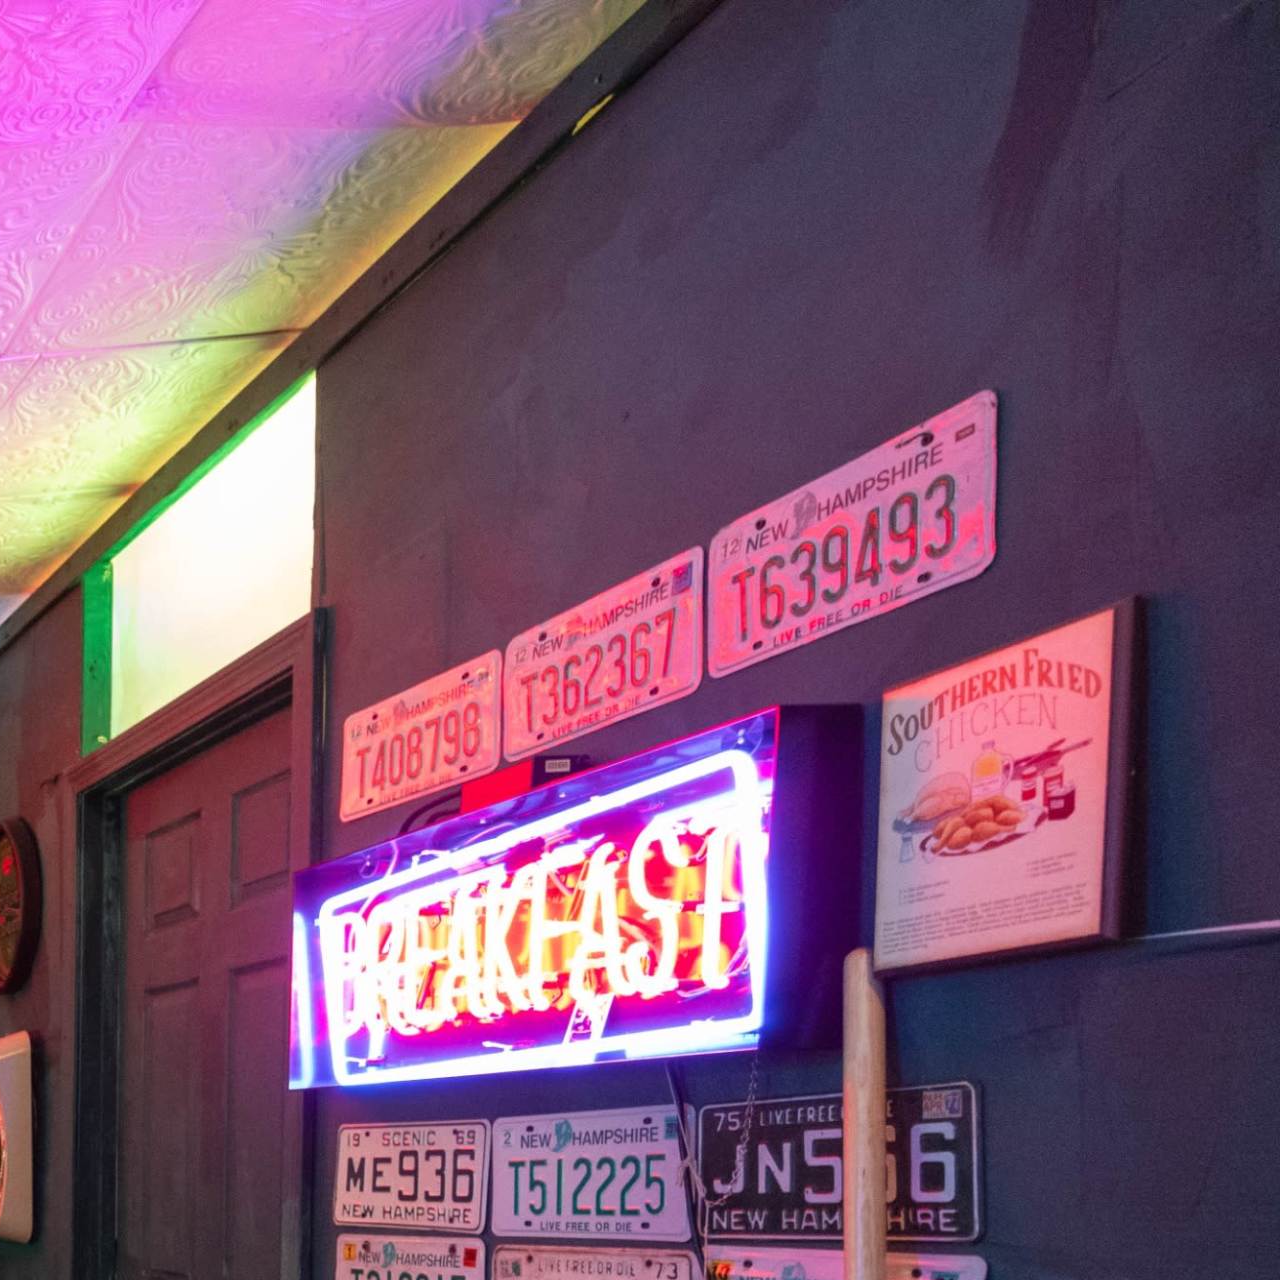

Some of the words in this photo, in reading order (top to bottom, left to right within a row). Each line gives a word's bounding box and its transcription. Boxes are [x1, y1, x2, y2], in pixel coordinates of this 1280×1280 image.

[722, 538, 739, 559] 12
[746, 520, 789, 554] NEW
[816, 442, 944, 521] HAMPSHIRE
[732, 474, 956, 642] T639493
[532, 634, 564, 660] NEW
[583, 582, 670, 637] HAMPSHIRE
[773, 629, 801, 649] LIVE
[809, 612, 843, 633] FREE
[851, 599, 871, 617] OR
[879, 584, 903, 605] DIE
[521, 607, 676, 733] T362367
[365, 717, 392, 736] NEW
[407, 681, 474, 717] HAMPSHIRE
[552, 723, 572, 739] LIVE
[577, 713, 600, 729] FREE
[887, 663, 1018, 756] SOUTHERN
[1022, 648, 1102, 700] FRIED
[356, 702, 480, 799] T408798
[914, 693, 1059, 774] CHICKEN
[332, 815, 745, 1036] BREAKFAST
[347, 1133, 360, 1147] 19
[382, 1131, 436, 1147] SCENIC
[455, 1130, 476, 1145] 69
[503, 1131, 511, 1145] 2
[520, 1134, 552, 1148] NEW
[572, 1127, 659, 1146] HAMPSHIRE
[713, 1112, 740, 1132] 75
[760, 1108, 791, 1126] LIVE
[797, 1105, 834, 1124] FREE
[346, 1148, 476, 1203] ME936
[508, 1154, 665, 1216] T512225
[713, 1121, 956, 1204] JN56
[342, 1205, 375, 1219] NEW
[382, 1206, 472, 1224] HAMPSHIRE
[540, 1221, 561, 1232] LIVE
[565, 1221, 590, 1232] FREE
[595, 1222, 610, 1232] OR
[615, 1222, 632, 1232] DIE
[712, 1209, 768, 1231] NEW
[782, 1208, 959, 1233] HAMHIRE
[358, 1252, 381, 1264] NEW
[396, 1254, 461, 1268] HAMPSHIRE
[538, 1259, 561, 1273] LIVE
[565, 1260, 592, 1275] FREE
[596, 1261, 612, 1275] OR
[617, 1262, 635, 1276] DIE
[655, 1263, 678, 1280] 73
